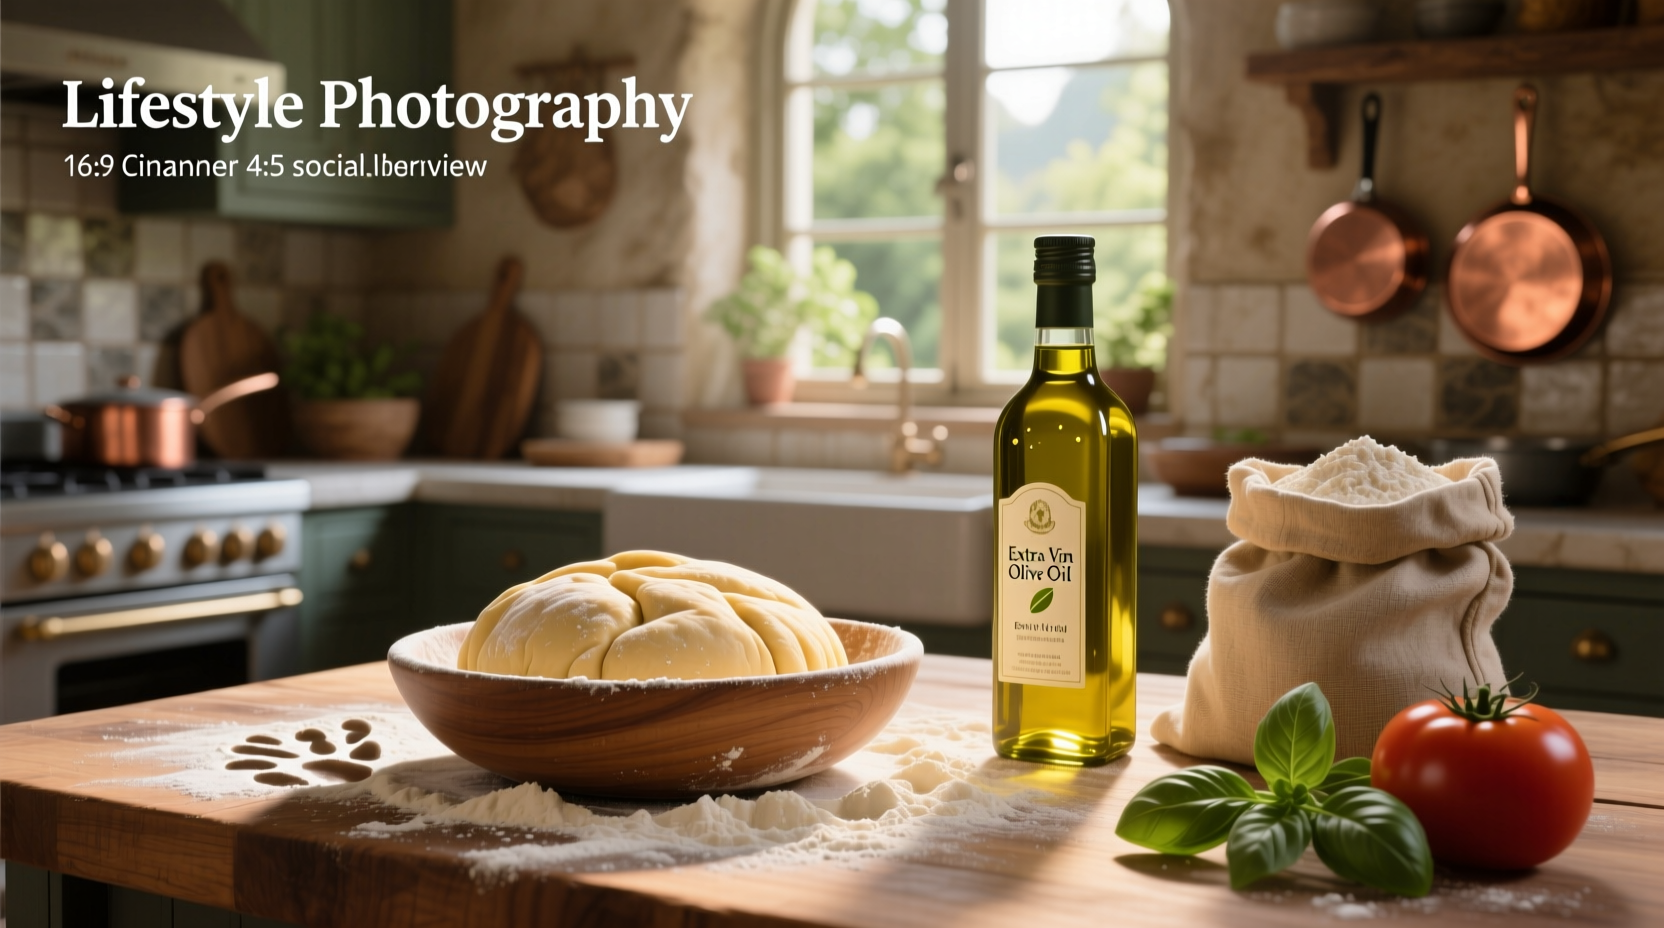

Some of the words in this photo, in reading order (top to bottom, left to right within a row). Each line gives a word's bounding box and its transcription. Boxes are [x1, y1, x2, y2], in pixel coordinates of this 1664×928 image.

[1008, 545, 1045, 562] Extra
[1008, 563, 1044, 581] Olive
[1047, 565, 1072, 582] Oil
